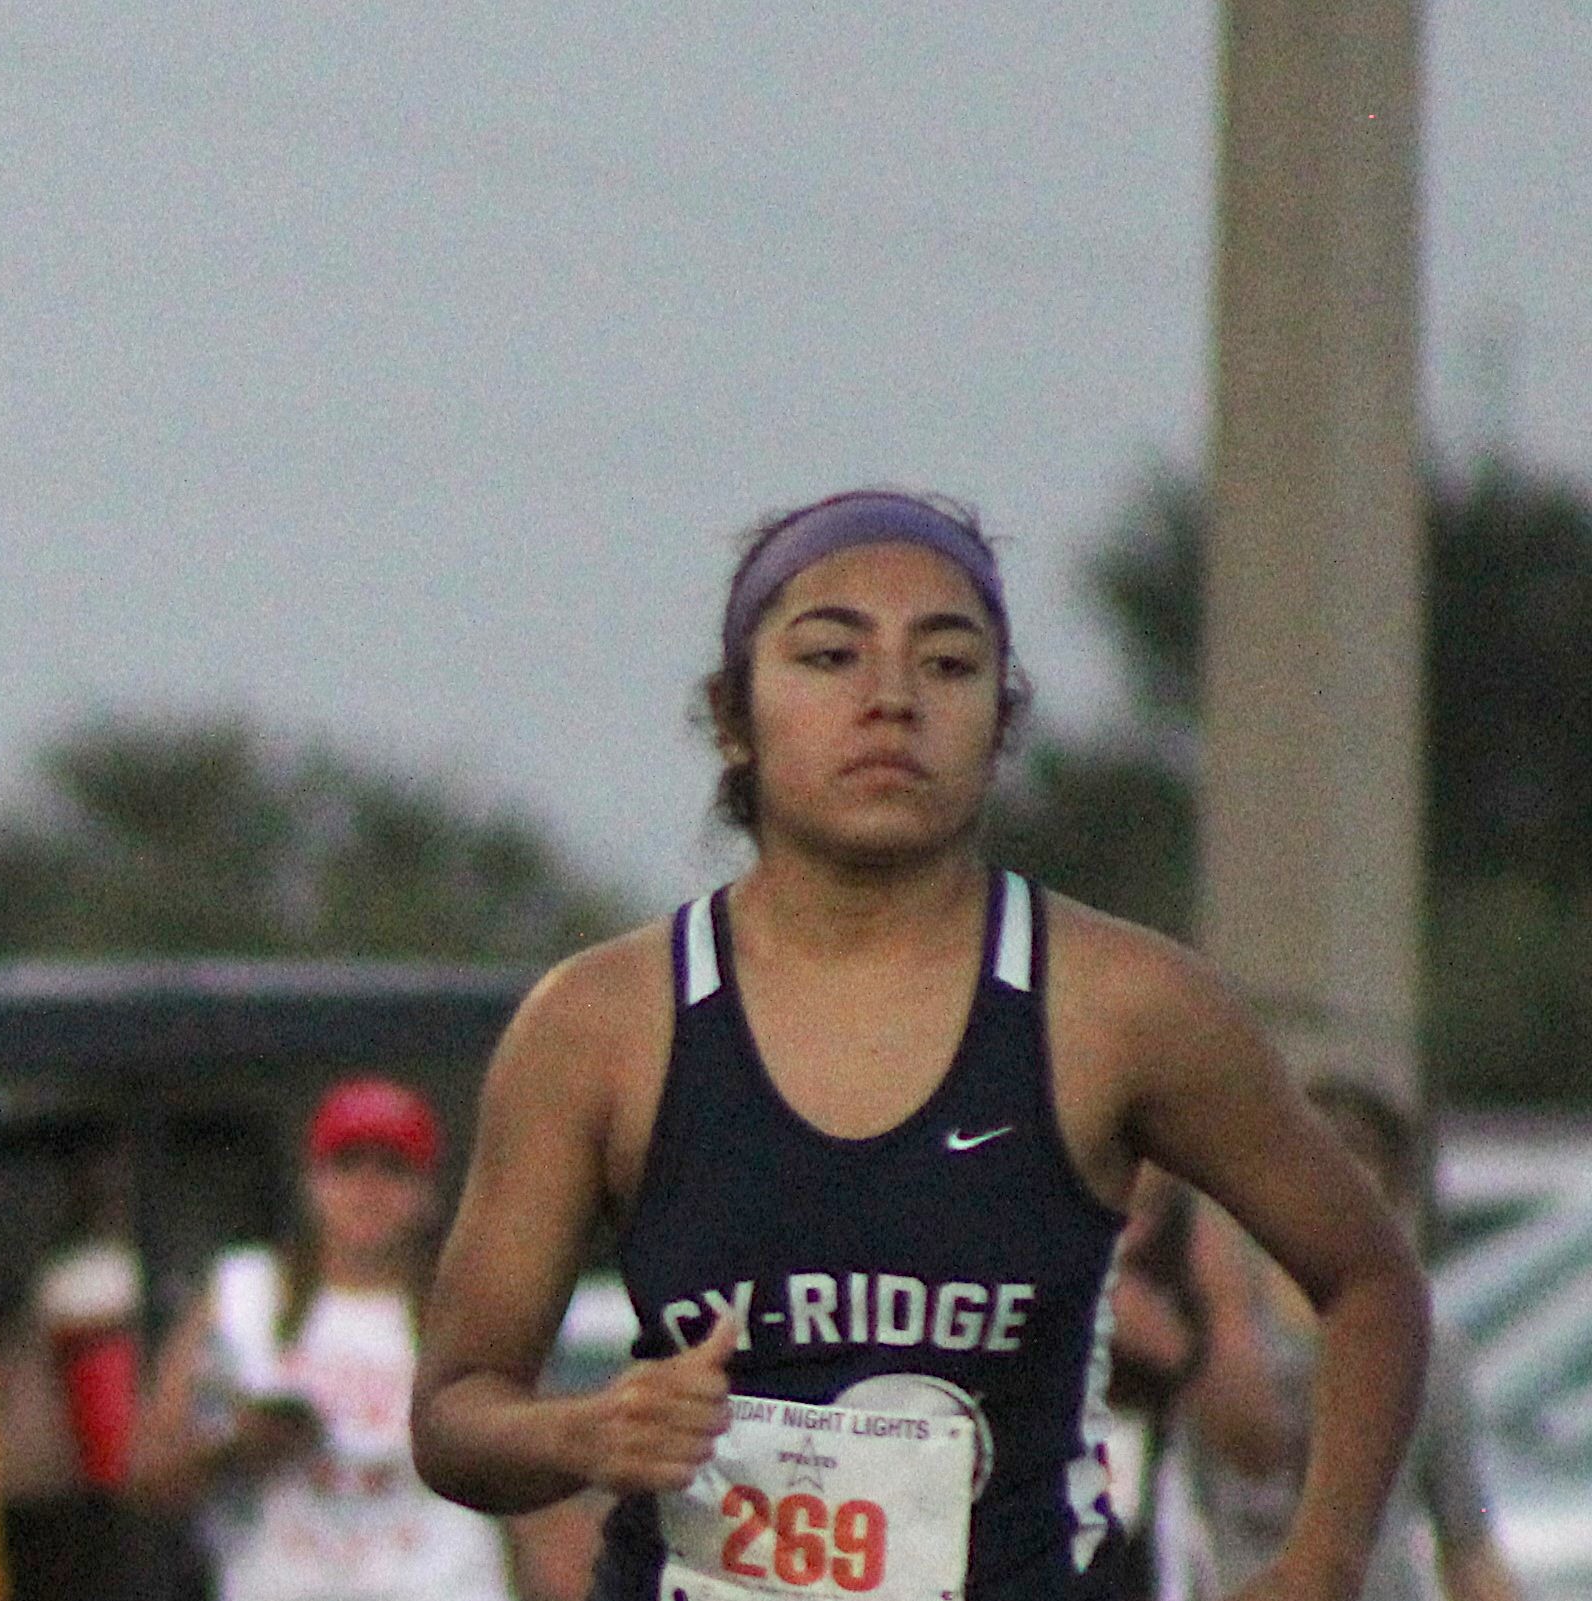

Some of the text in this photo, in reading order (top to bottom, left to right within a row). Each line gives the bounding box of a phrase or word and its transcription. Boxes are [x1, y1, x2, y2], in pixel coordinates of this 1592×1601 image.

[662, 1272, 1037, 1352] CY-RIDGE
[783, 1406, 847, 1431] NIGHT
[852, 1412, 931, 1440] LIGHTS
[721, 1484, 889, 1594] 269
